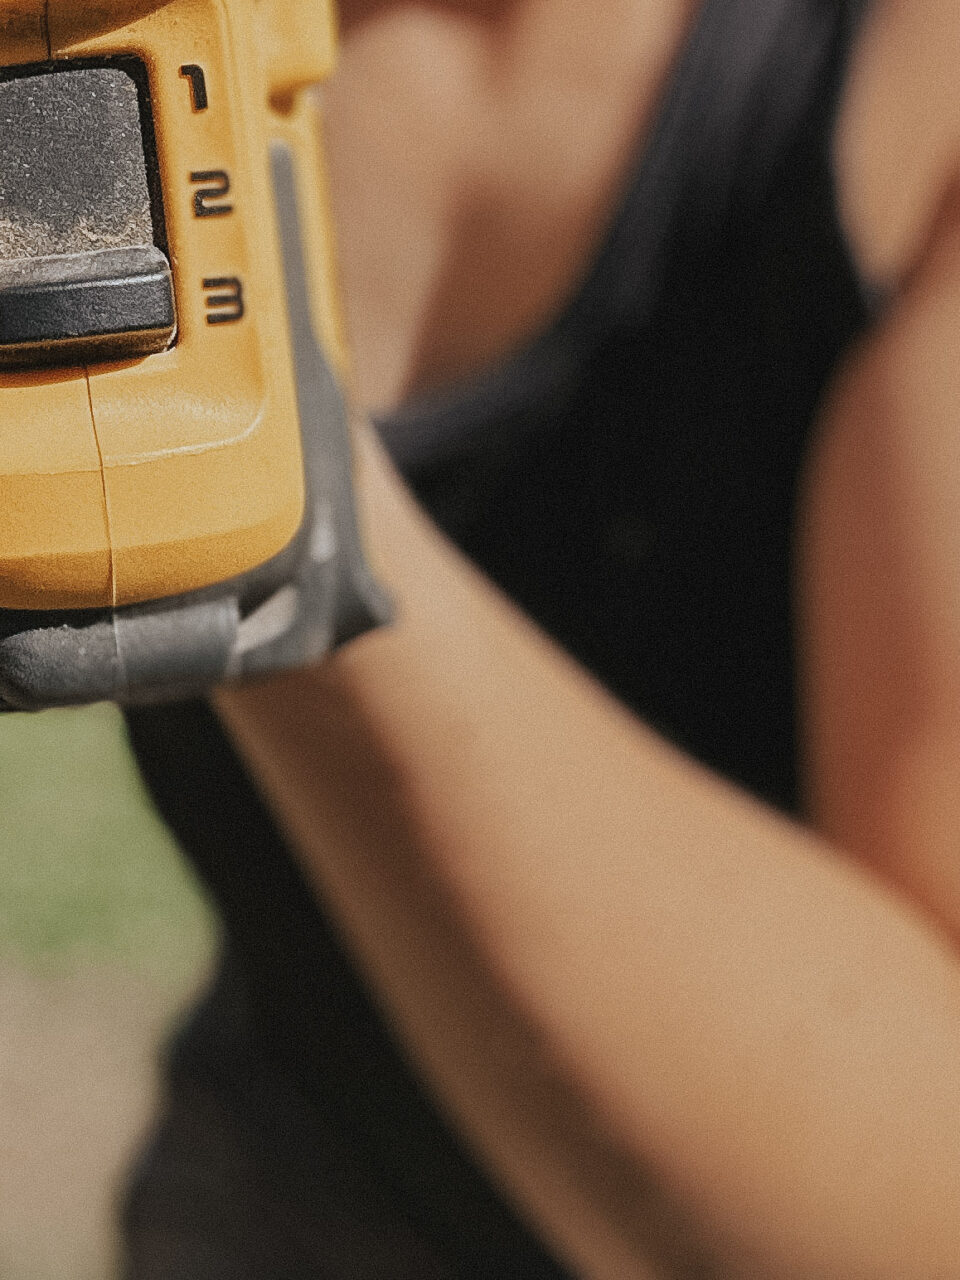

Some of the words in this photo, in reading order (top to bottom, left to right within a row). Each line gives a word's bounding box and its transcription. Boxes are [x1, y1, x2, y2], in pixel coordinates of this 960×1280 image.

[180, 64, 209, 110] 1
[190, 170, 232, 217] 2
[202, 277, 244, 324] 3
